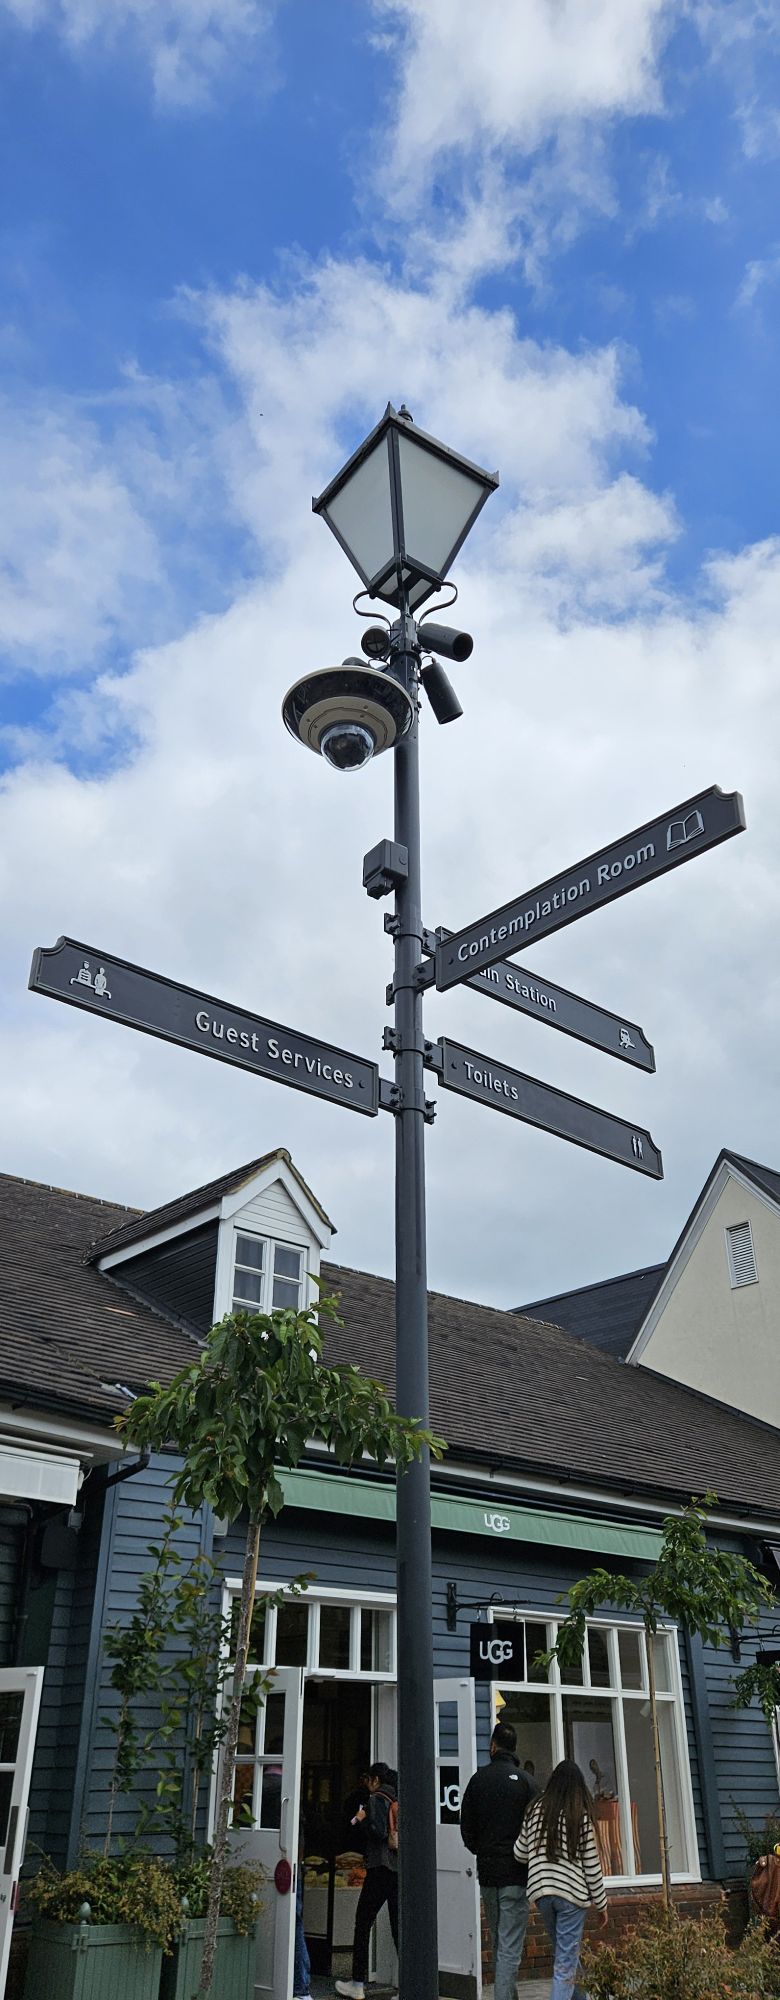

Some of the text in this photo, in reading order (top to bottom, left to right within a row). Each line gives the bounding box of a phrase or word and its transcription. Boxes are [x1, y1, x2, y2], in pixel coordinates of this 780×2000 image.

[458, 843, 655, 961] Contemplation Room
[506, 974, 557, 1011] Station
[195, 1012, 354, 1088] Guest Services
[464, 1061, 519, 1100] Toilets
[484, 1513, 510, 1532] UGG
[480, 1639, 513, 1664] UGG
[440, 1784, 460, 1811] UG
